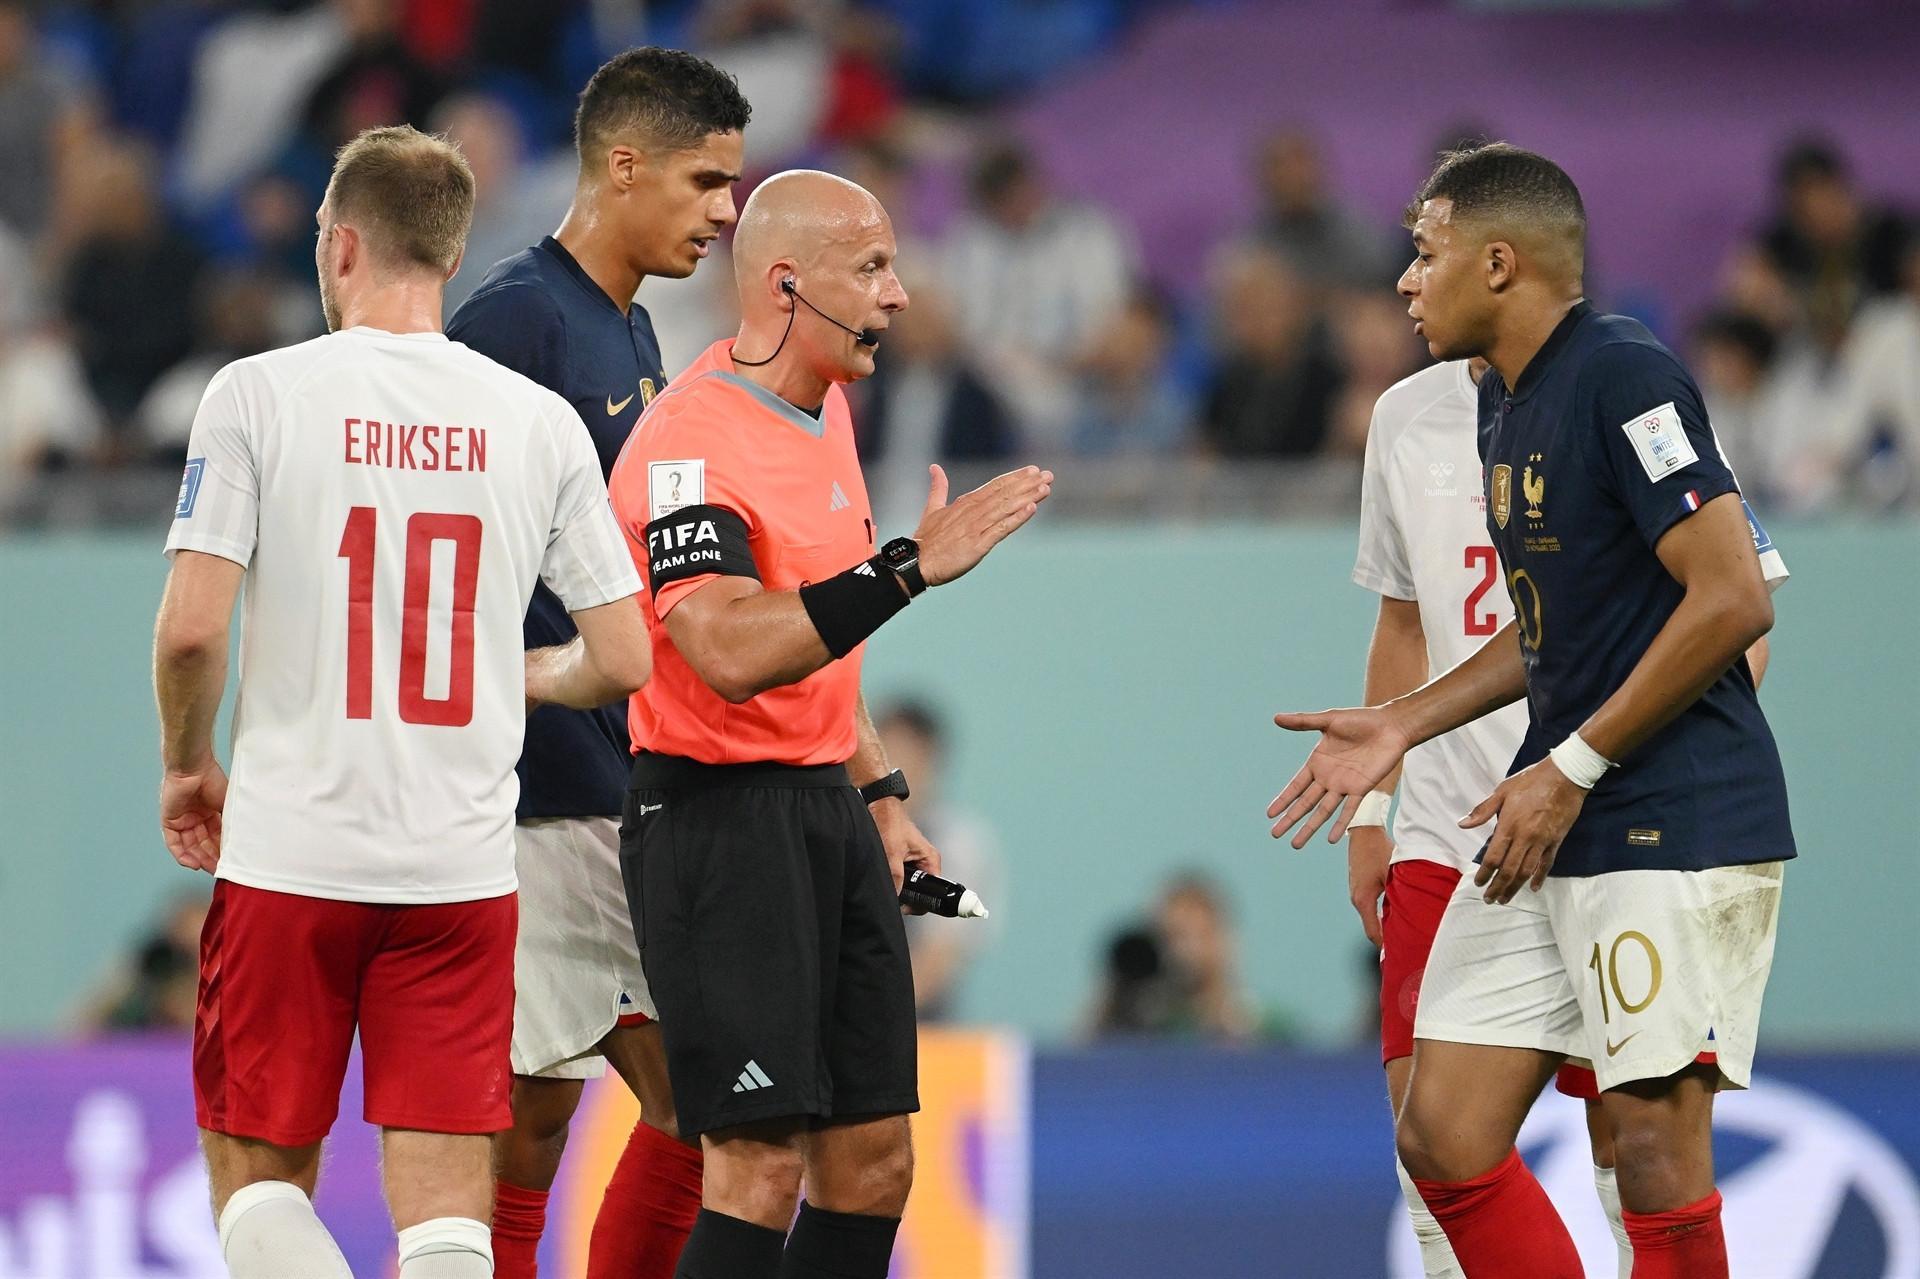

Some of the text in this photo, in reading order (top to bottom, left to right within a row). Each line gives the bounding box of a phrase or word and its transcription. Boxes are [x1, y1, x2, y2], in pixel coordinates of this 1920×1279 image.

[345, 418, 486, 472] ERIKSEN
[1651, 438, 1675, 456] UNITES
[649, 520, 720, 559] FIFA
[689, 549, 722, 563] ONE
[337, 505, 483, 727] 10
[1464, 545, 1498, 636] 2
[1589, 930, 1662, 1024] 10
